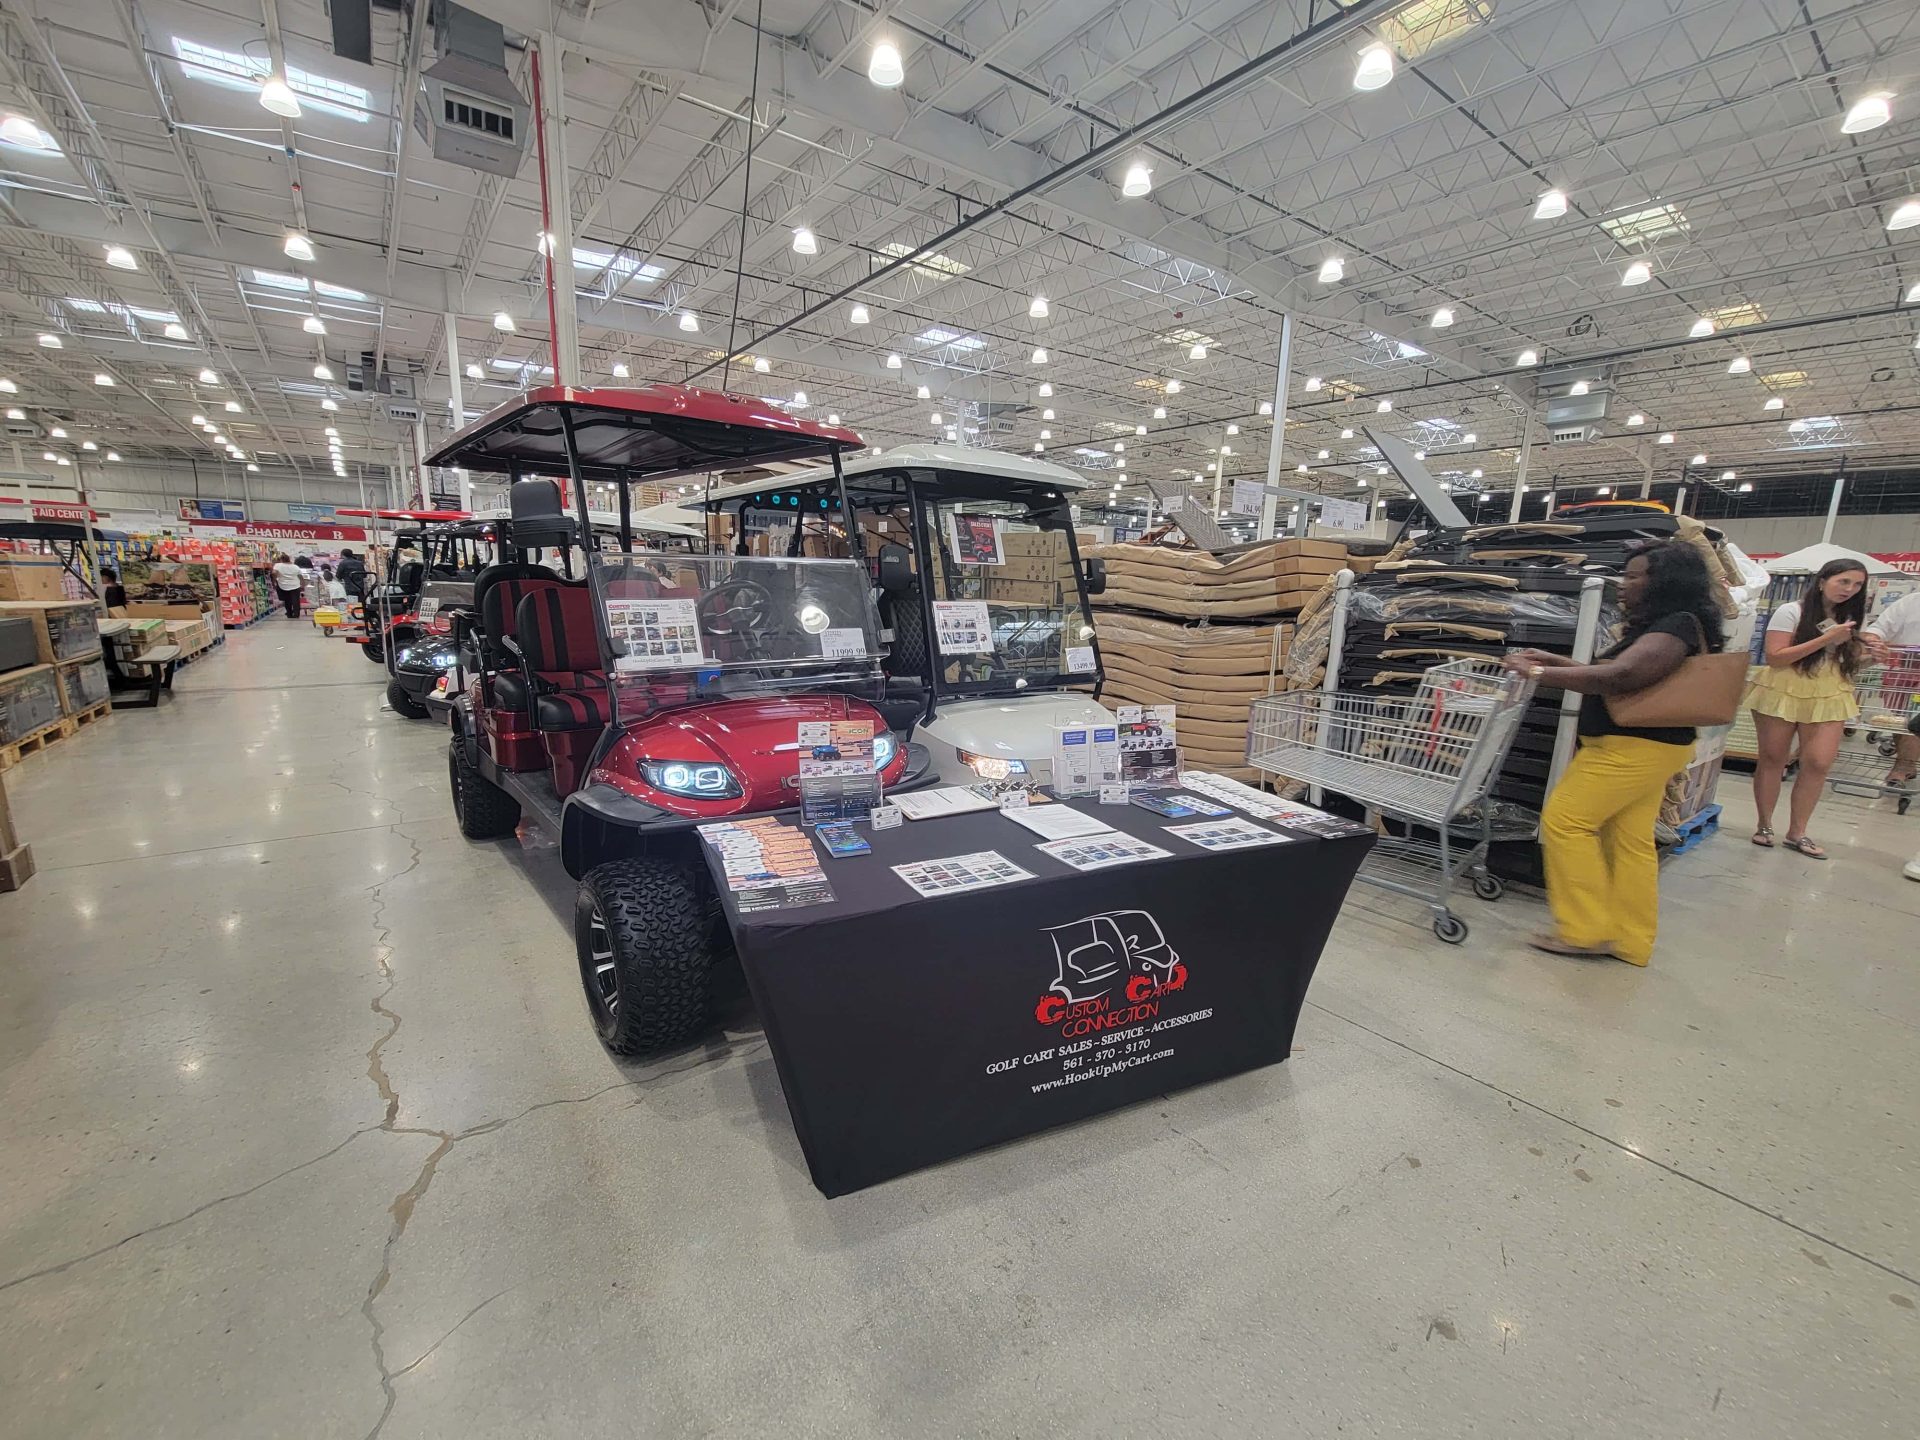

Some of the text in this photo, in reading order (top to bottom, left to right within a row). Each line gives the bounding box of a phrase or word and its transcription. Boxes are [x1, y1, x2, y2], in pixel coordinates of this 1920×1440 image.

[40, 508, 55, 517] AID
[57, 509, 91, 519] CENTE
[1242, 503, 1262, 515] 184.99
[245, 527, 316, 540] PHARMACY
[848, 727, 869, 735] ICON
[1035, 995, 1110, 1026] CUSTOM
[1062, 1001, 1159, 1039] CONNECTION
[986, 1057, 1020, 1075] GOLF
[1023, 1048, 1055, 1066] CART
[1058, 1039, 1093, 1057] SALES
[1101, 1026, 1144, 1047] SERVICE
[1151, 1008, 1214, 1034] ACCESSORIES
[1063, 1056, 1084, 1071] 561
[1095, 1047, 1116, 1063] 370
[1125, 1038, 1152, 1055] 3170
[1031, 1048, 1175, 1094] www.HookUpMyCart.com
